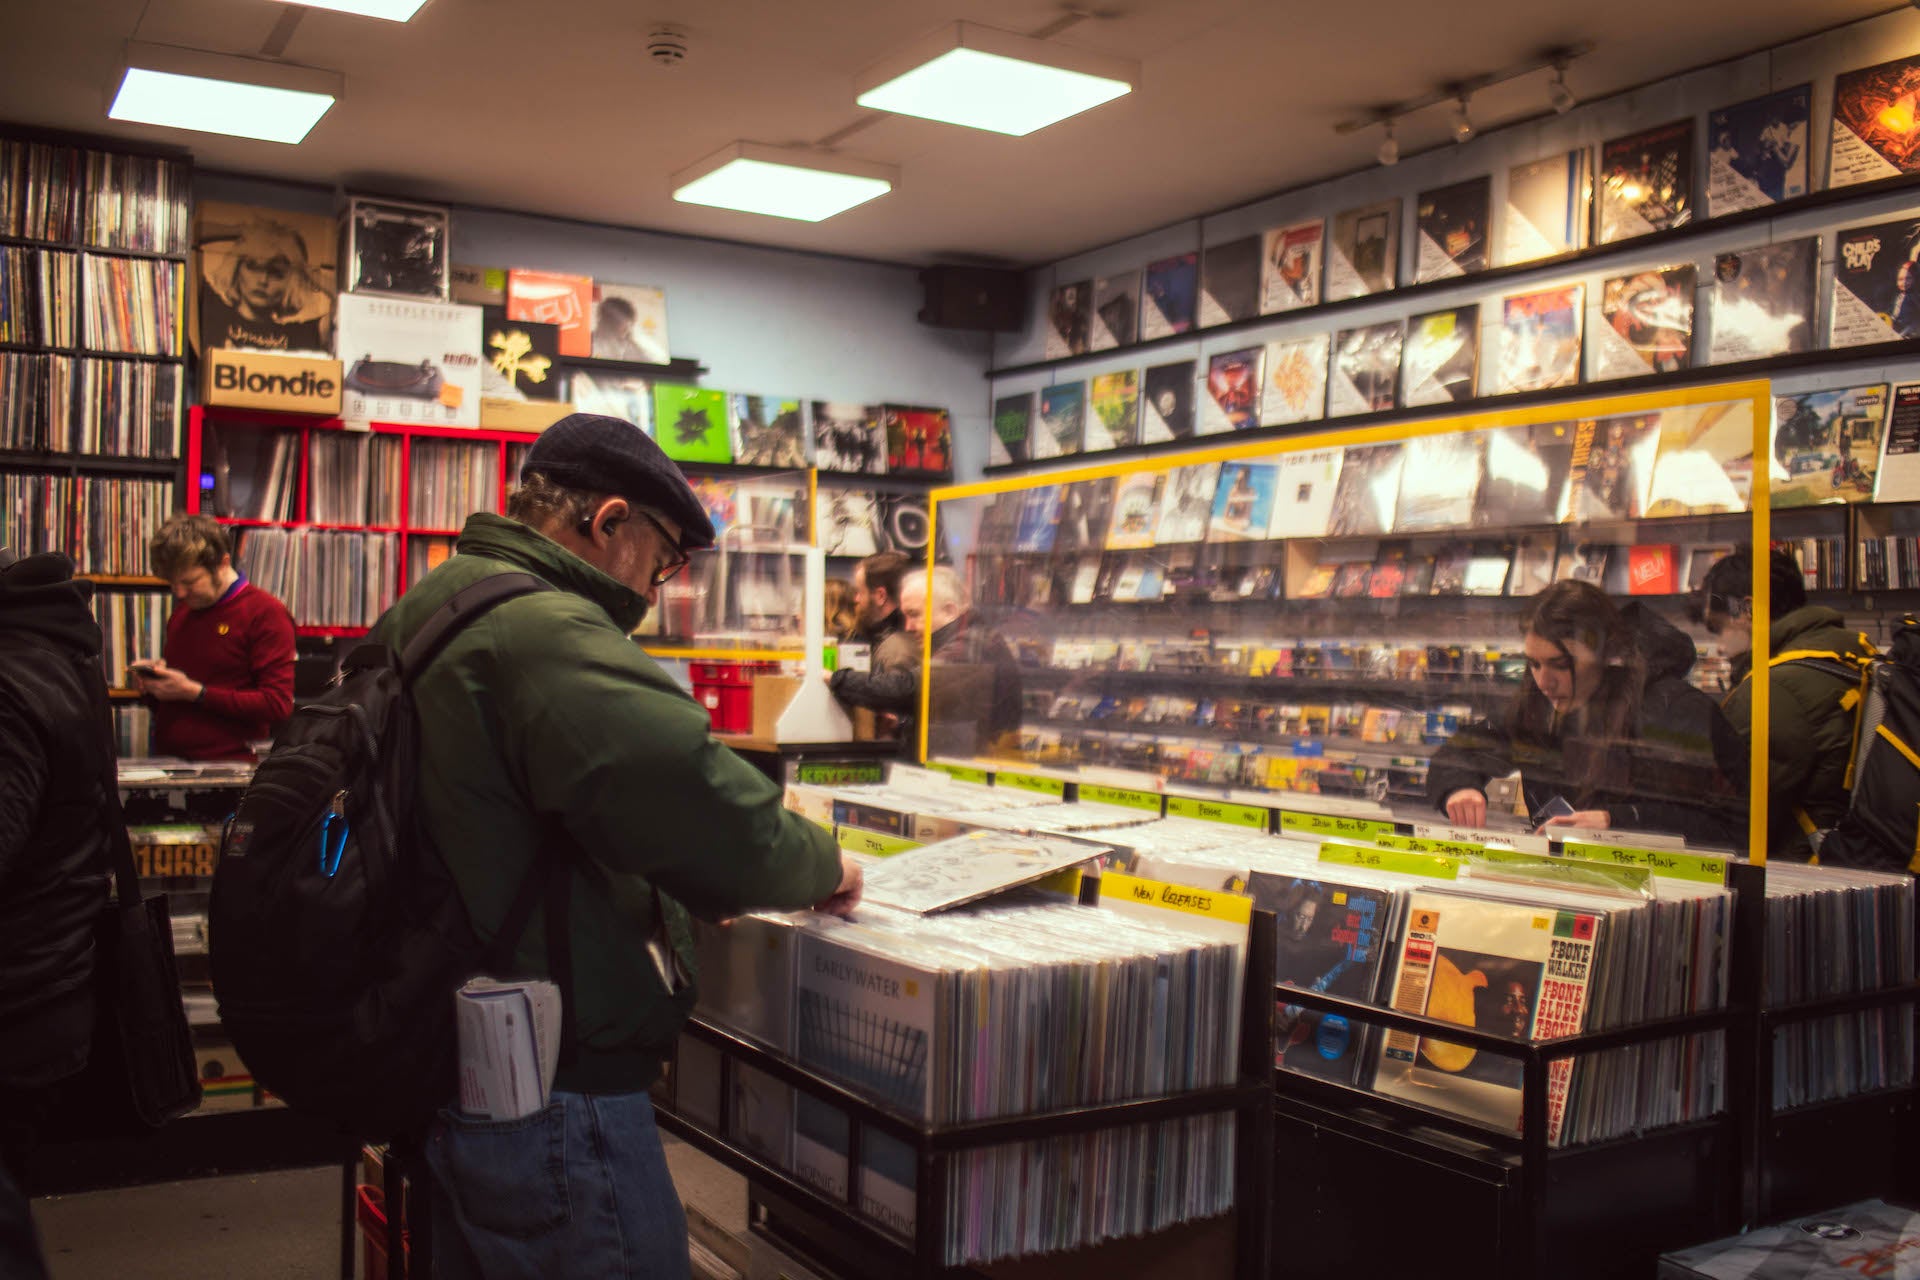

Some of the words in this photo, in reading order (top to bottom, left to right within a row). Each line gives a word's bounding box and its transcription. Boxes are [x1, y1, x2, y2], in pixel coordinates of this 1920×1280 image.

[1846, 253, 1875, 272] PLAY
[214, 364, 335, 398] Blondie
[801, 765, 882, 785] KRYPTON
[1133, 884, 1155, 900] NEW
[1162, 886, 1212, 911] RELEASES
[1551, 940, 1590, 962] T-BONE
[1548, 958, 1587, 980] WALKER
[1543, 979, 1584, 1004] T-BONE
[1538, 999, 1580, 1023] BLUES
